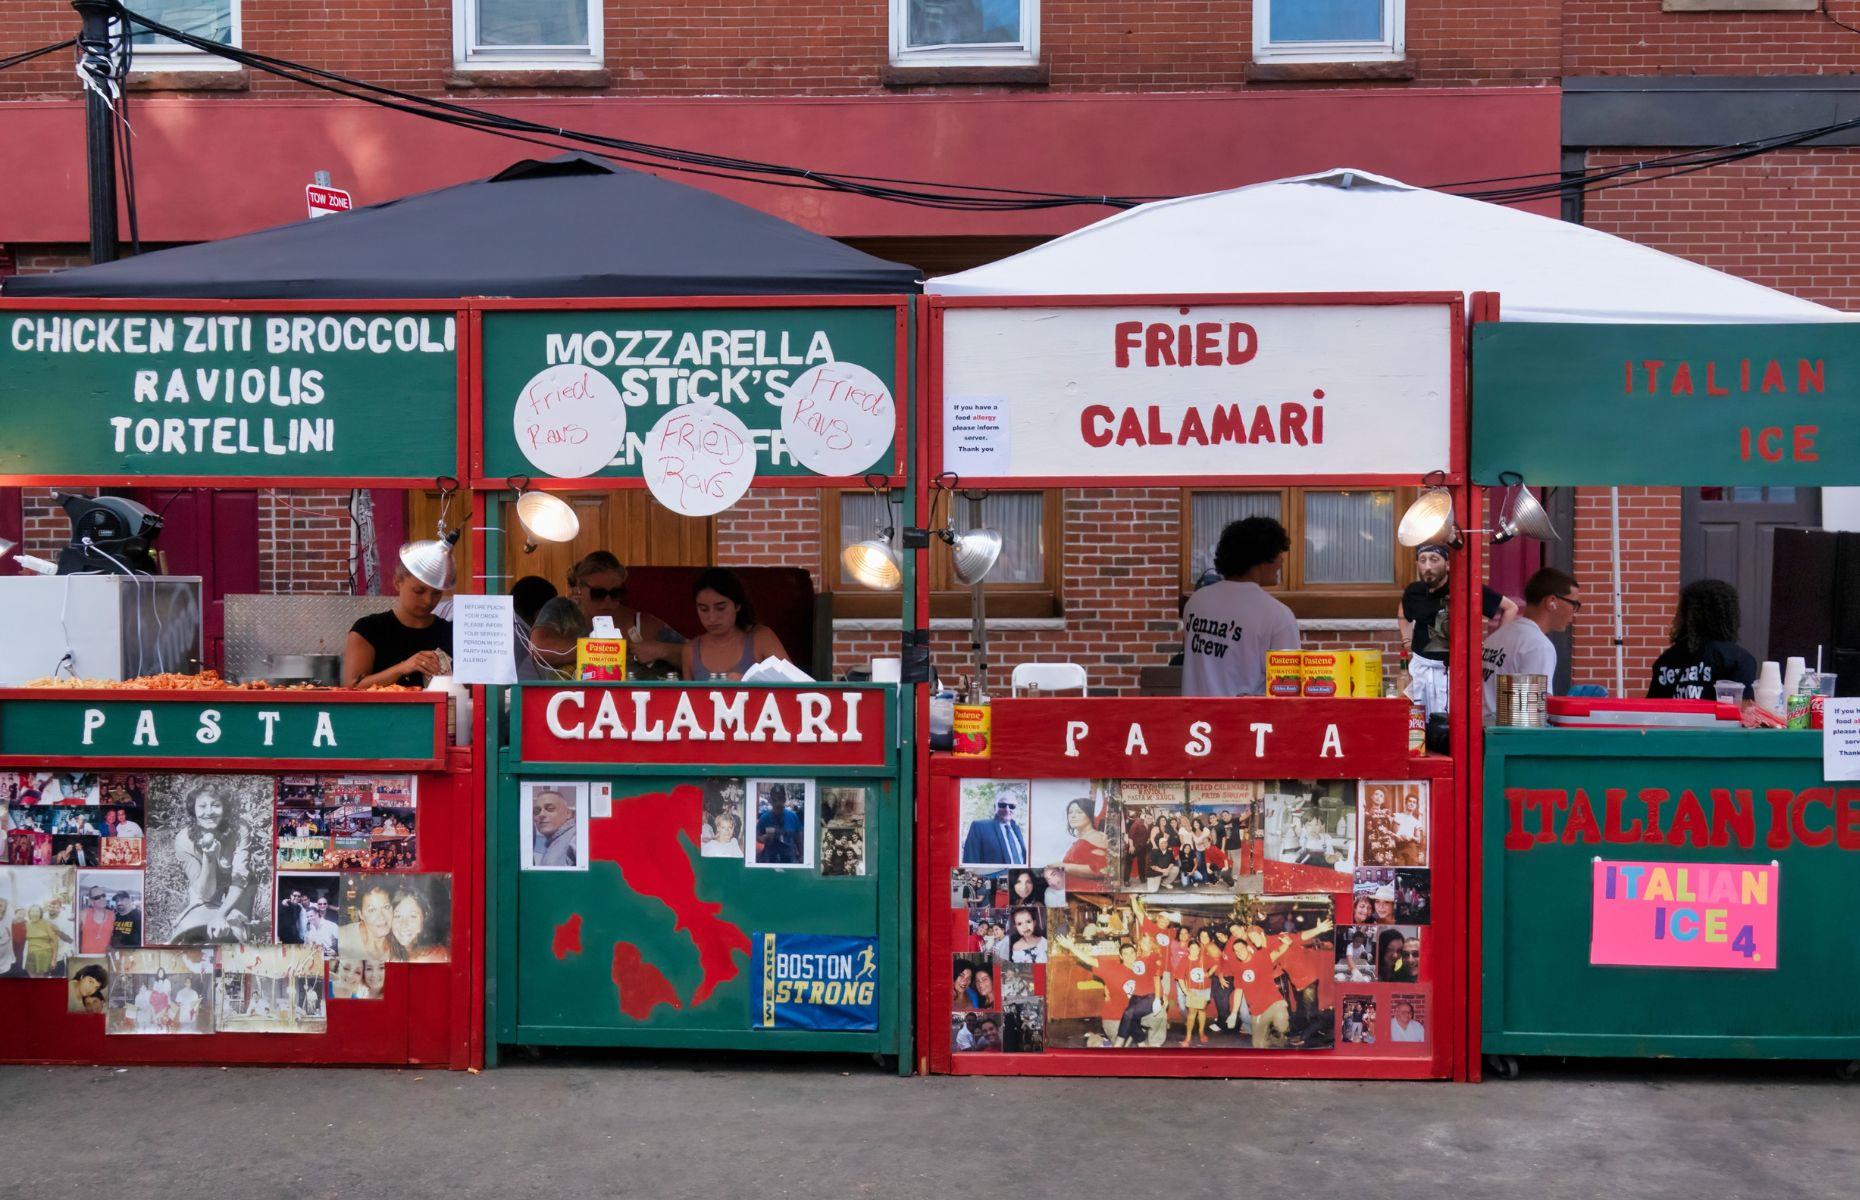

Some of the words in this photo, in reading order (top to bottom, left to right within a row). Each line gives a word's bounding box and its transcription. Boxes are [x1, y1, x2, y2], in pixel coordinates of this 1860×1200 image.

[309, 192, 327, 204] TOW
[328, 195, 349, 209] ZONE
[11, 316, 175, 353] CHICKEN
[182, 316, 252, 352] ZITI
[265, 316, 457, 354] BROCCOLI
[545, 329, 836, 367] MOZZARELLA
[133, 365, 325, 406] RAVIOLIS
[1624, 358, 1826, 396] ITALIAN
[109, 416, 334, 455] TORTELLINI
[1739, 425, 1820, 463] ICE
[1185, 613, 1243, 643] Jenna's
[1190, 634, 1229, 659] Crew
[589, 643, 619, 652] Pastene
[1271, 656, 1299, 665] Pastene
[1304, 656, 1333, 665] Pastene
[81, 708, 338, 747] PASTA
[545, 689, 864, 743] CALAMARI
[1063, 720, 1345, 758] PASTA
[1503, 787, 1757, 851] ITALIAN
[1765, 787, 1860, 851] ICE
[1605, 865, 1769, 905] ITALIAN
[1654, 907, 1729, 943] ICE
[776, 953, 852, 980] BOSTON
[775, 980, 875, 1006] STRONG
